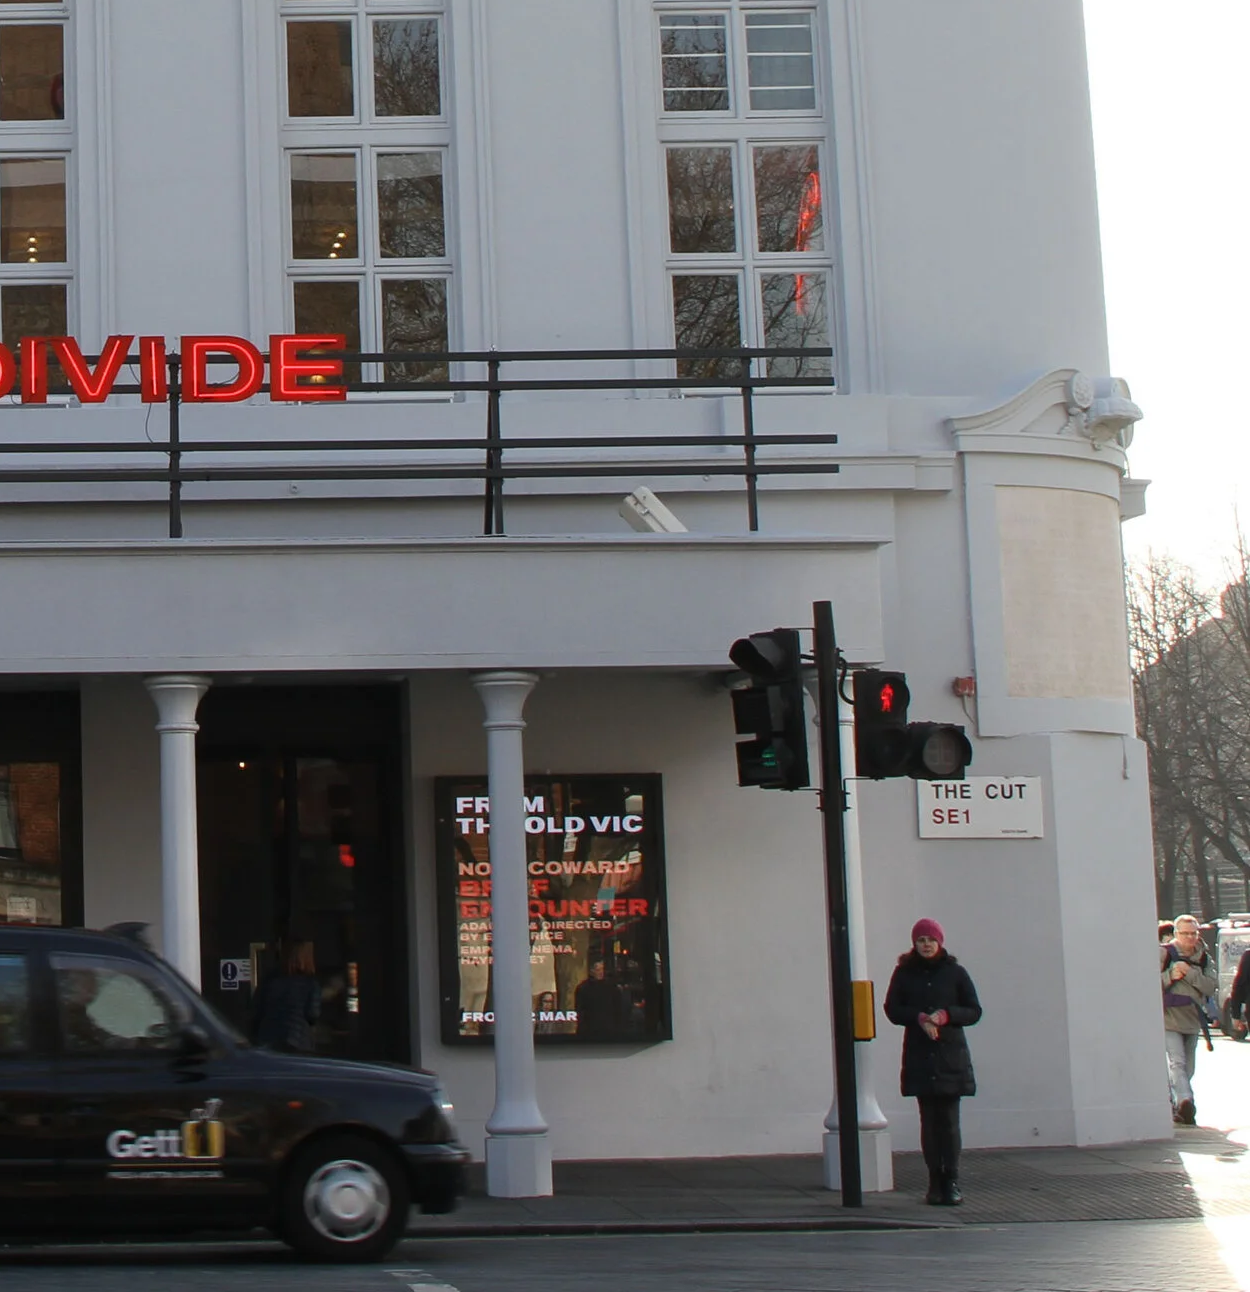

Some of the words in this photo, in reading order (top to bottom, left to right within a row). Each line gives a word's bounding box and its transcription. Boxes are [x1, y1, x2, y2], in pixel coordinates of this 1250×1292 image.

[931, 783, 972, 799] THE
[985, 783, 1026, 799] CUT
[455, 796, 545, 814] FRM
[932, 808, 970, 824] SE1
[524, 816, 586, 834] OLD
[590, 815, 643, 833] VIC
[528, 860, 631, 875] COWARD
[542, 920, 612, 930] DIRECTED
[460, 932, 480, 941] BY
[530, 931, 564, 940] RICE
[462, 1011, 495, 1022] FRO
[539, 1011, 578, 1022] MAR
